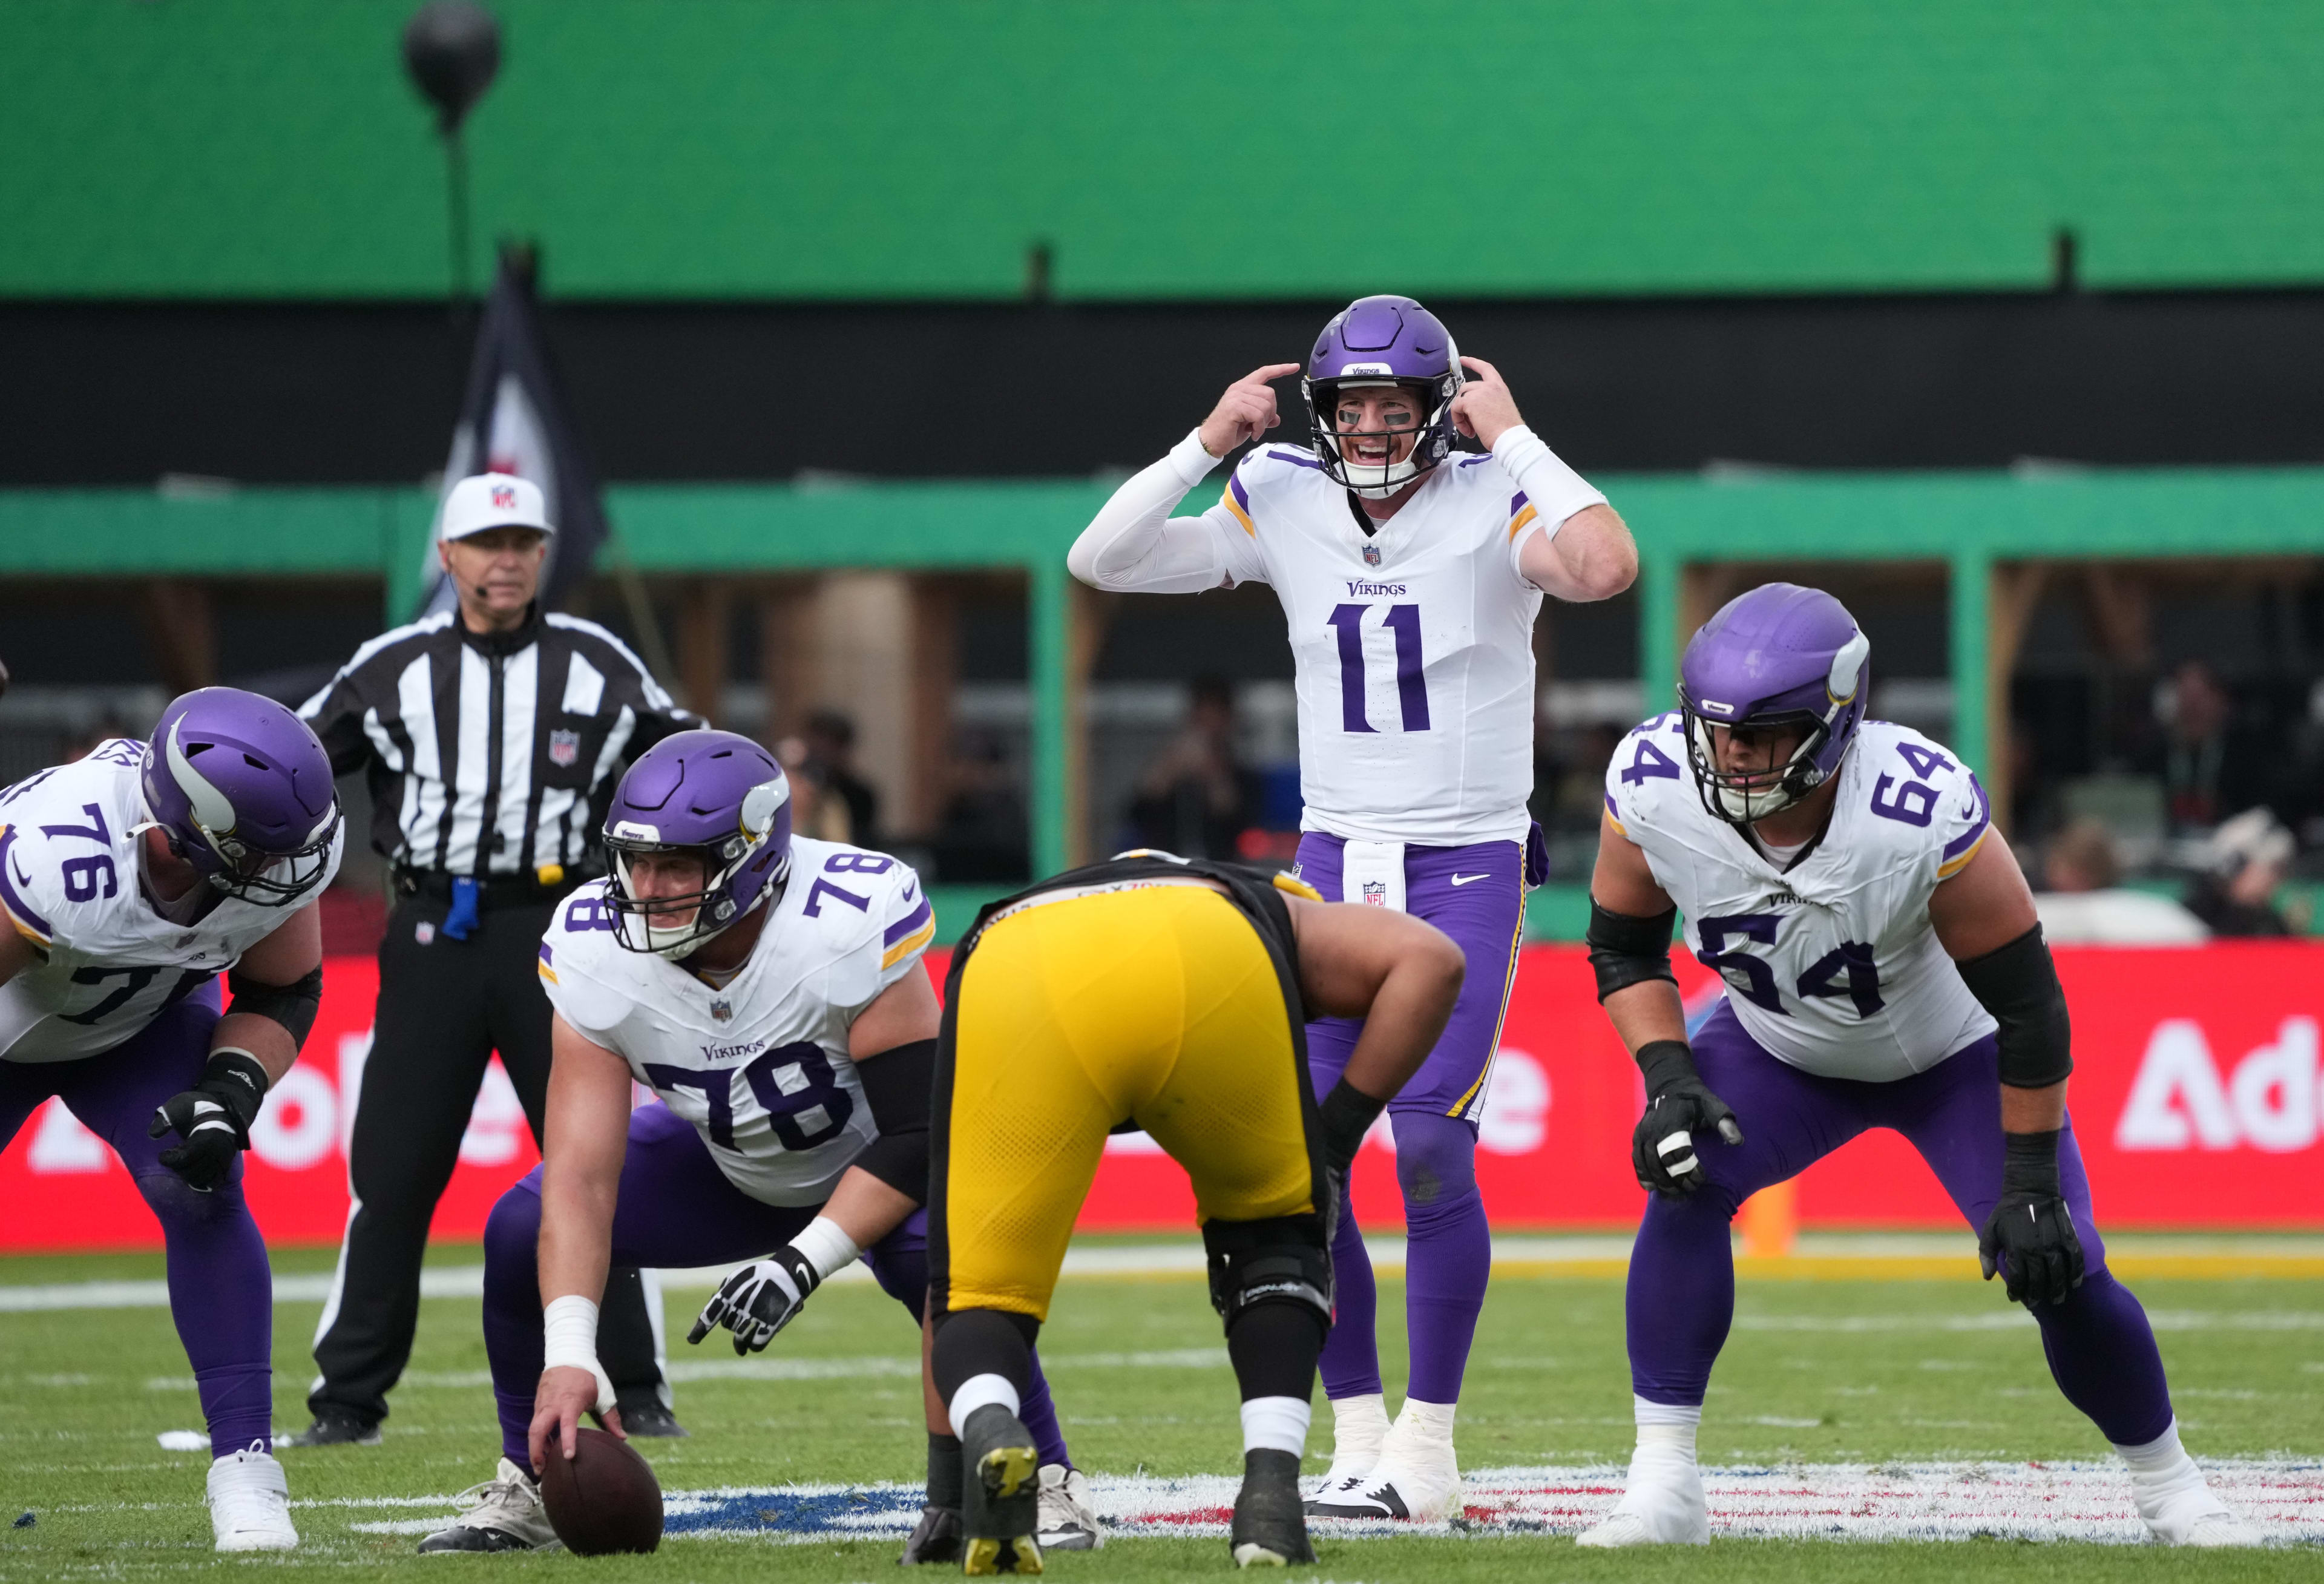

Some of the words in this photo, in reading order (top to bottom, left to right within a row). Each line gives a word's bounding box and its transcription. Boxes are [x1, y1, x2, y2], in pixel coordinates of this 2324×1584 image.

[1347, 577, 1407, 597] VIKINGS
[1365, 553, 1379, 564] NFL
[1327, 603, 1431, 733] 11
[1870, 741, 1957, 828] 64
[39, 803, 118, 903] 76
[803, 853, 894, 919] 78
[564, 879, 620, 933] 8
[1367, 894, 1384, 907] NFL
[700, 1040, 765, 1062] VIKINGS
[2113, 1015, 2324, 1153] Ad
[642, 1041, 853, 1155] 78
